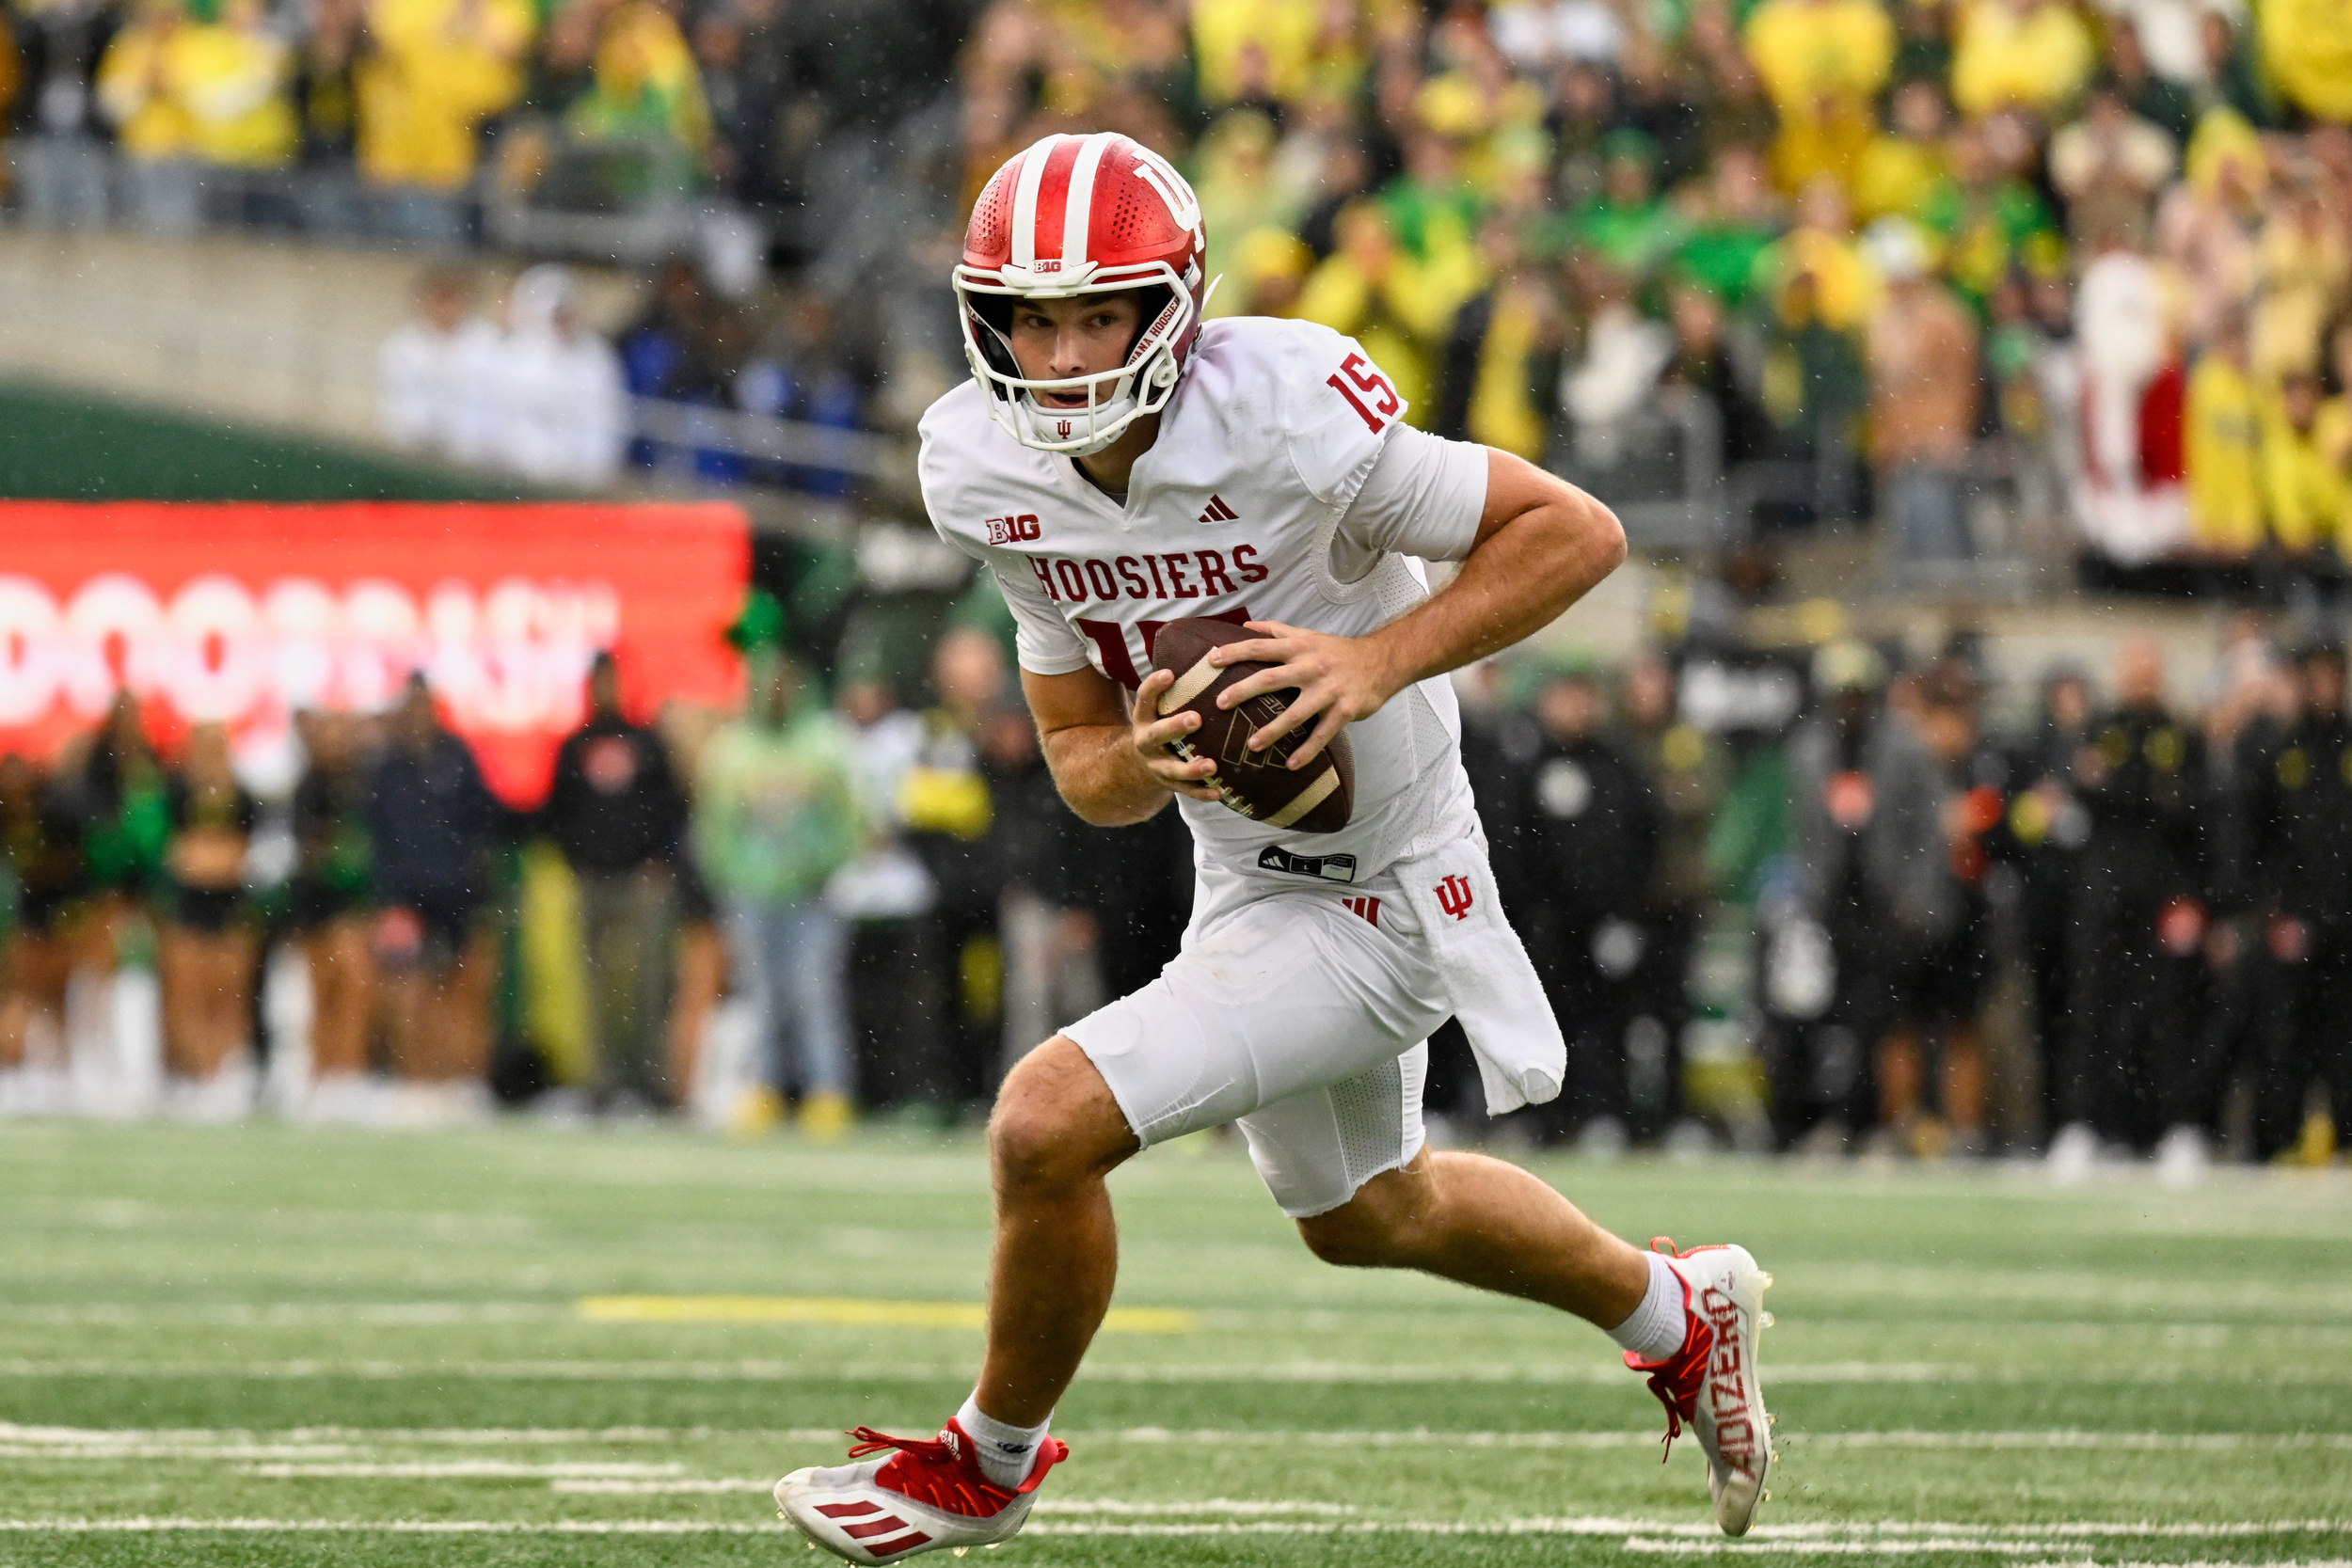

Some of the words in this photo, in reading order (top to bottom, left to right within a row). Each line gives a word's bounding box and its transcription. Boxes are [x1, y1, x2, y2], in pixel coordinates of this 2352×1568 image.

[1326, 351, 1399, 436] 15
[1025, 544, 1269, 603] HOOSIERS
[1701, 1286, 1756, 1481] ADIZERO
